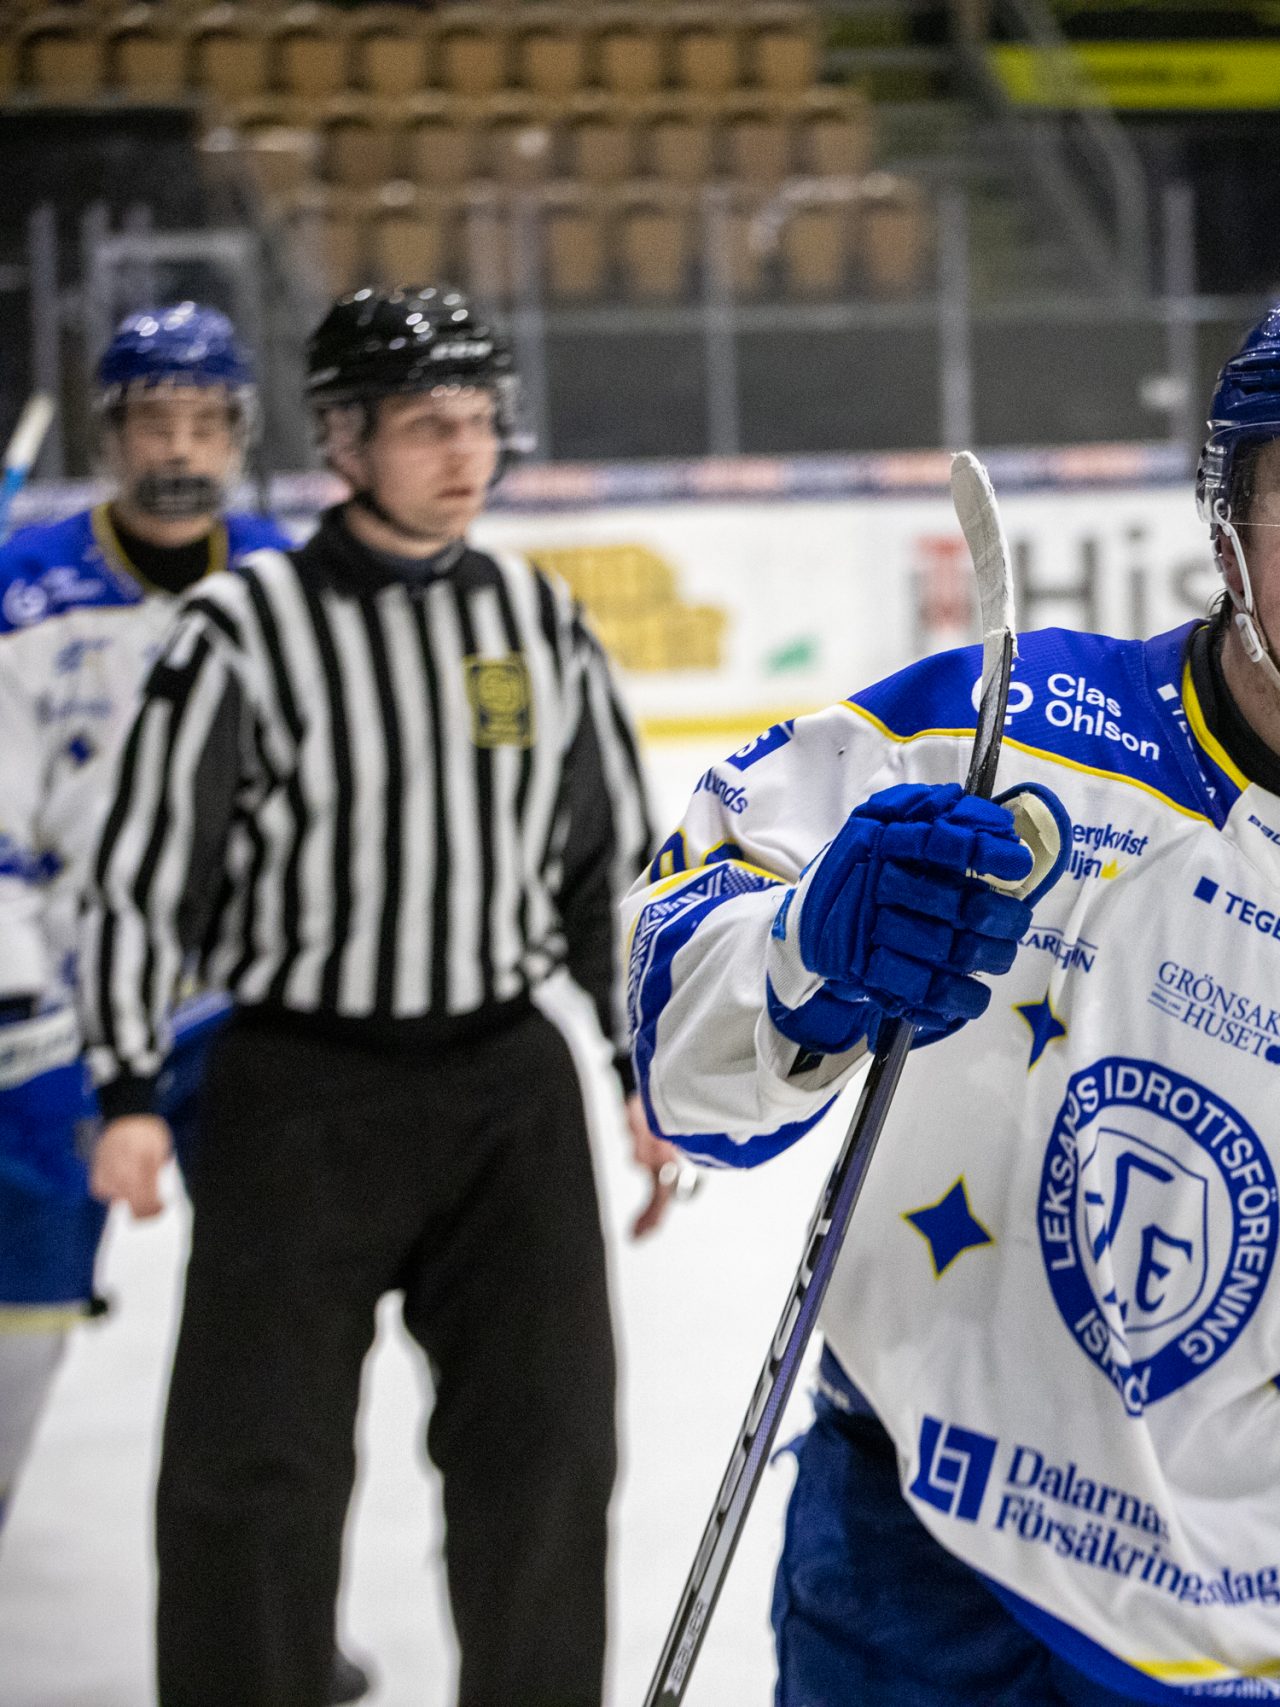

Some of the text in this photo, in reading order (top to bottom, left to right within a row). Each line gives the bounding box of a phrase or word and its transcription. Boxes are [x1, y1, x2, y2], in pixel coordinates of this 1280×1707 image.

[1046, 673, 1122, 718] Clas
[1045, 700, 1160, 761] Ohlson
[1072, 823, 1149, 857] ergkvist
[1182, 1004, 1272, 1058] HUSET
